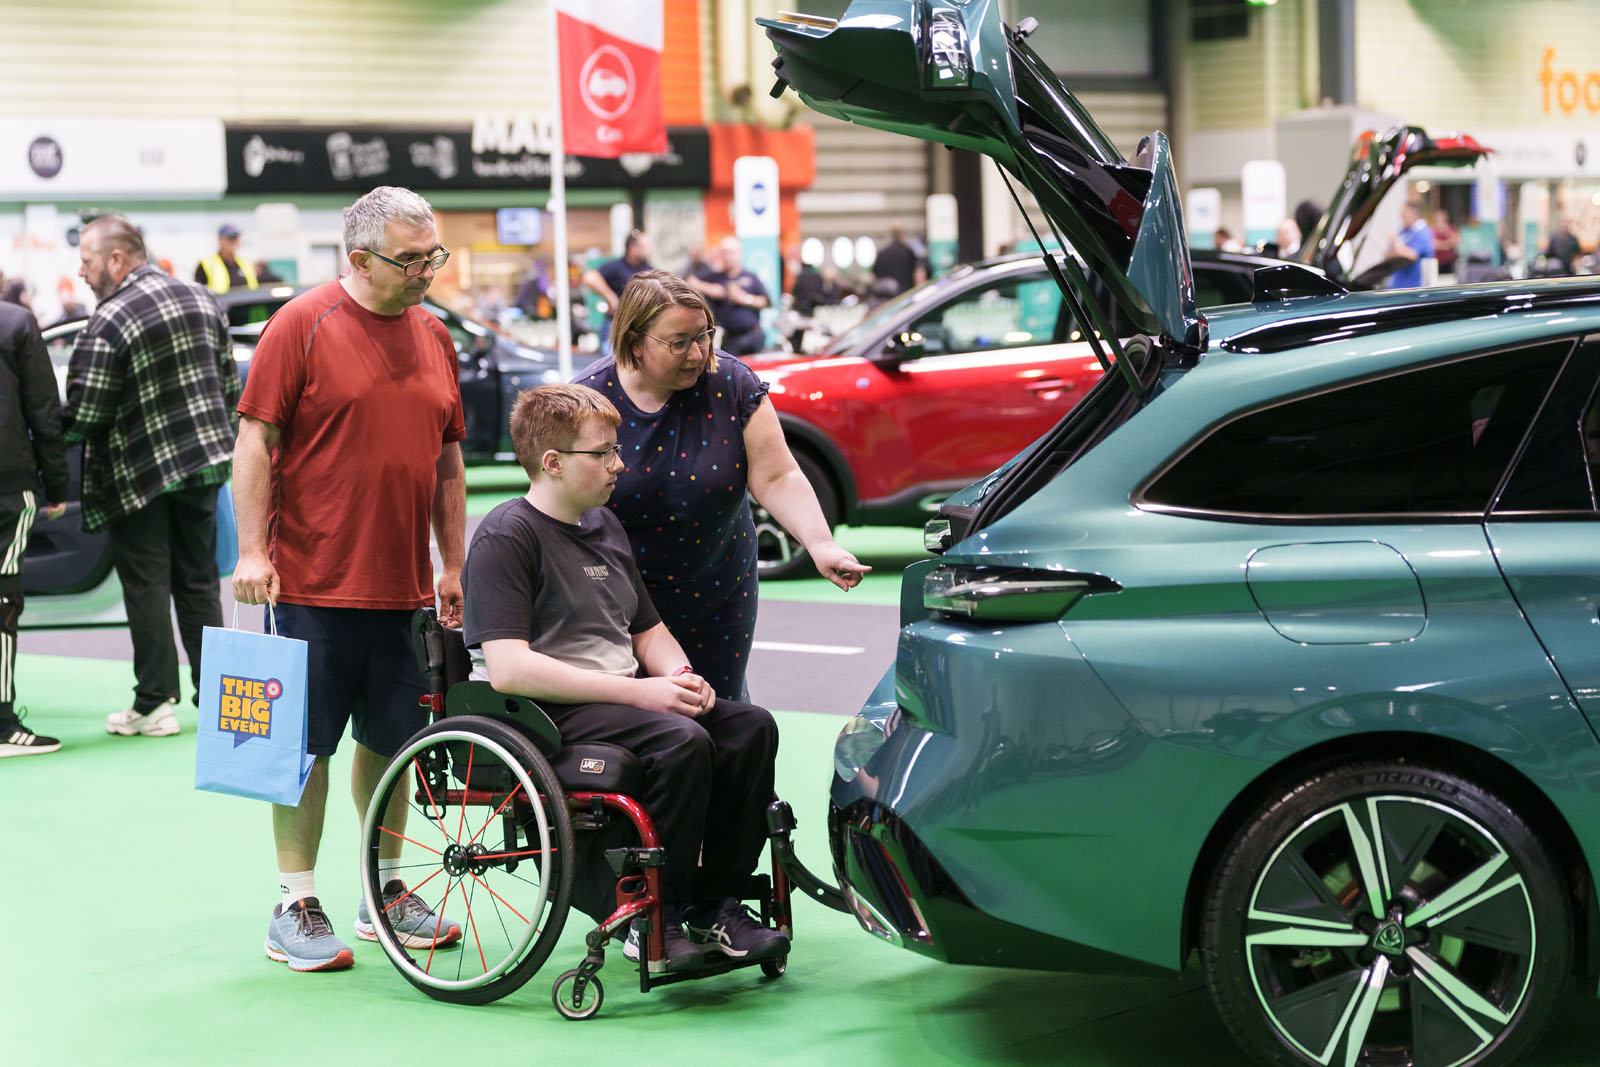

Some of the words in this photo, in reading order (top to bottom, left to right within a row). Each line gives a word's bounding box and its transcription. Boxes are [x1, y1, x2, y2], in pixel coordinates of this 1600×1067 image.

[222, 678, 265, 698] THE
[221, 696, 270, 722] BIG
[220, 718, 269, 735] EVENT
[582, 760, 598, 768] JAY
[1363, 773, 1456, 793] MICHELIN
